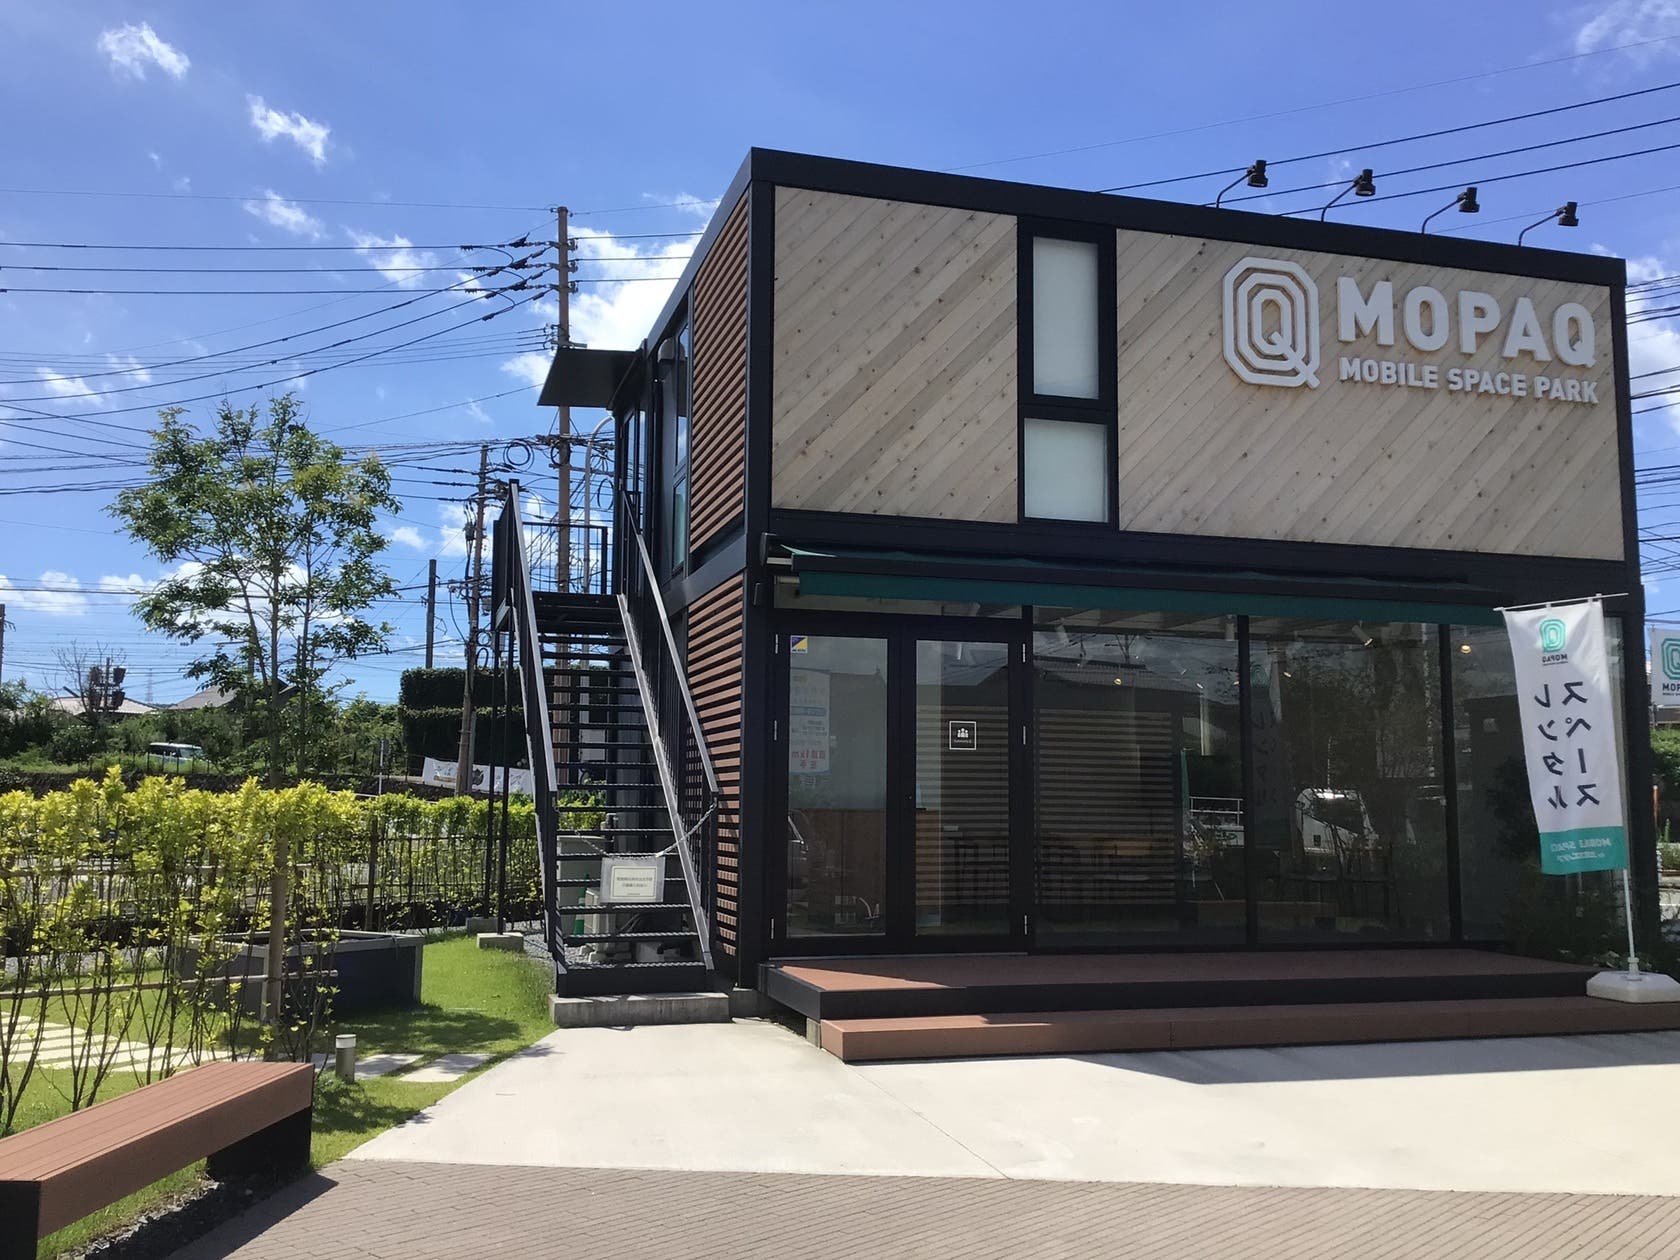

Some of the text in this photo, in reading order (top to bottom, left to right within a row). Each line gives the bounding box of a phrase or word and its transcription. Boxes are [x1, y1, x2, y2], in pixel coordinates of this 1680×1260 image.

[1337, 276, 1597, 369] MOPAQ
[1338, 357, 1600, 405] MOBILE SPACE PARK
